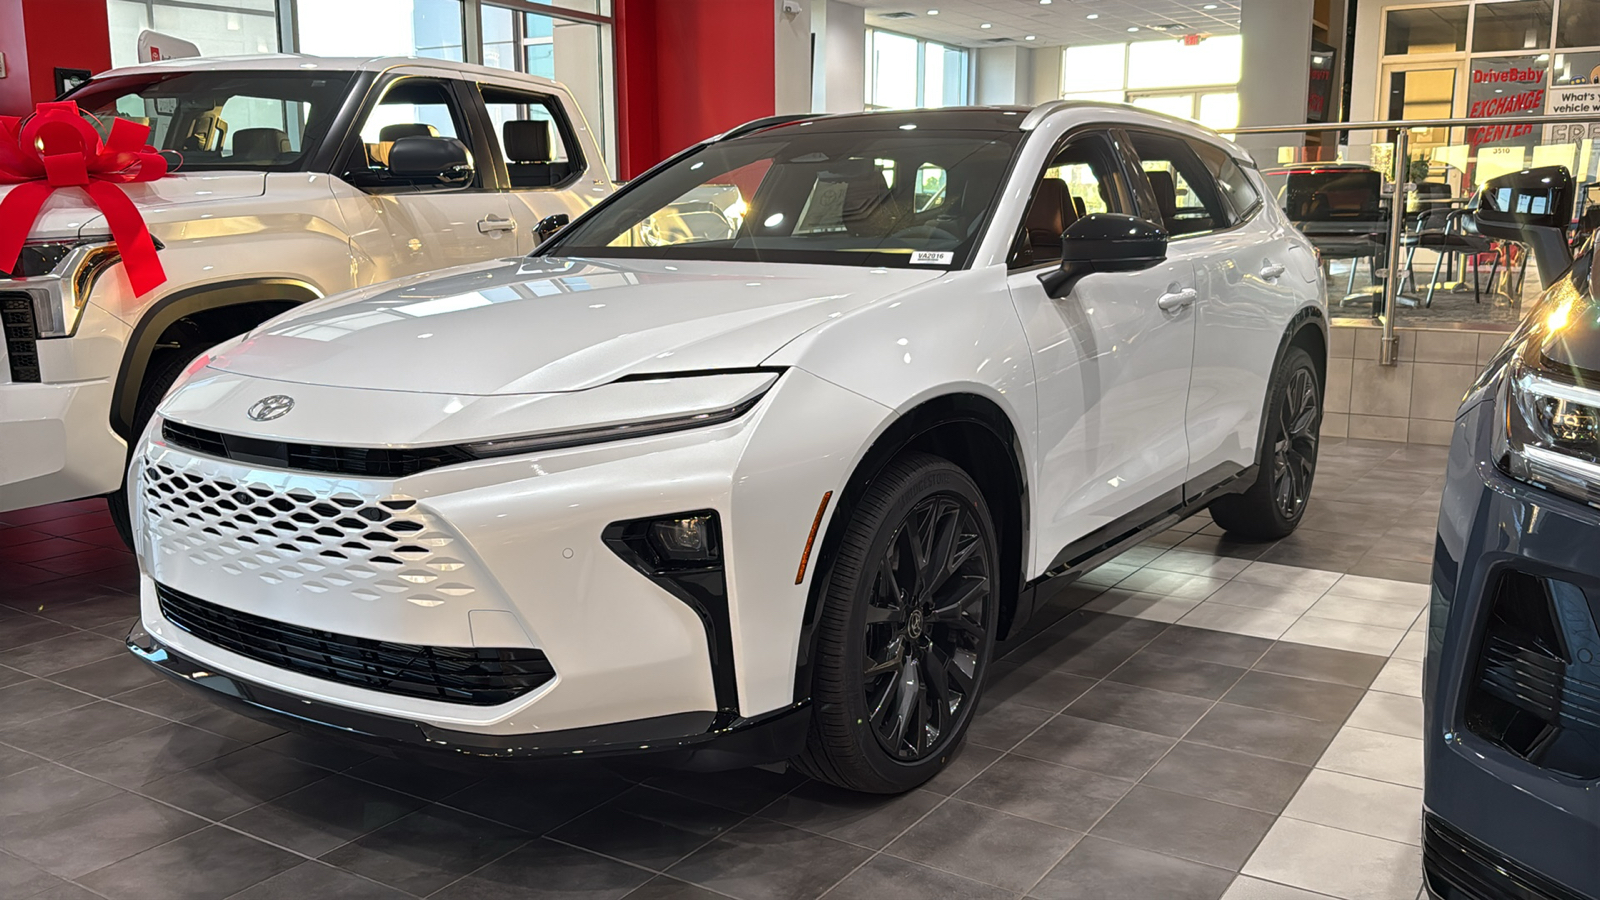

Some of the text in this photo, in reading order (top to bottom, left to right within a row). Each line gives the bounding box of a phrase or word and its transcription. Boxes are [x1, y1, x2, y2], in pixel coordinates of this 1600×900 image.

[1473, 67, 1544, 83] DriveBaby
[1470, 89, 1544, 118] EXCHANGE
[1562, 93, 1595, 102] What's
[1553, 103, 1590, 113] vehicle
